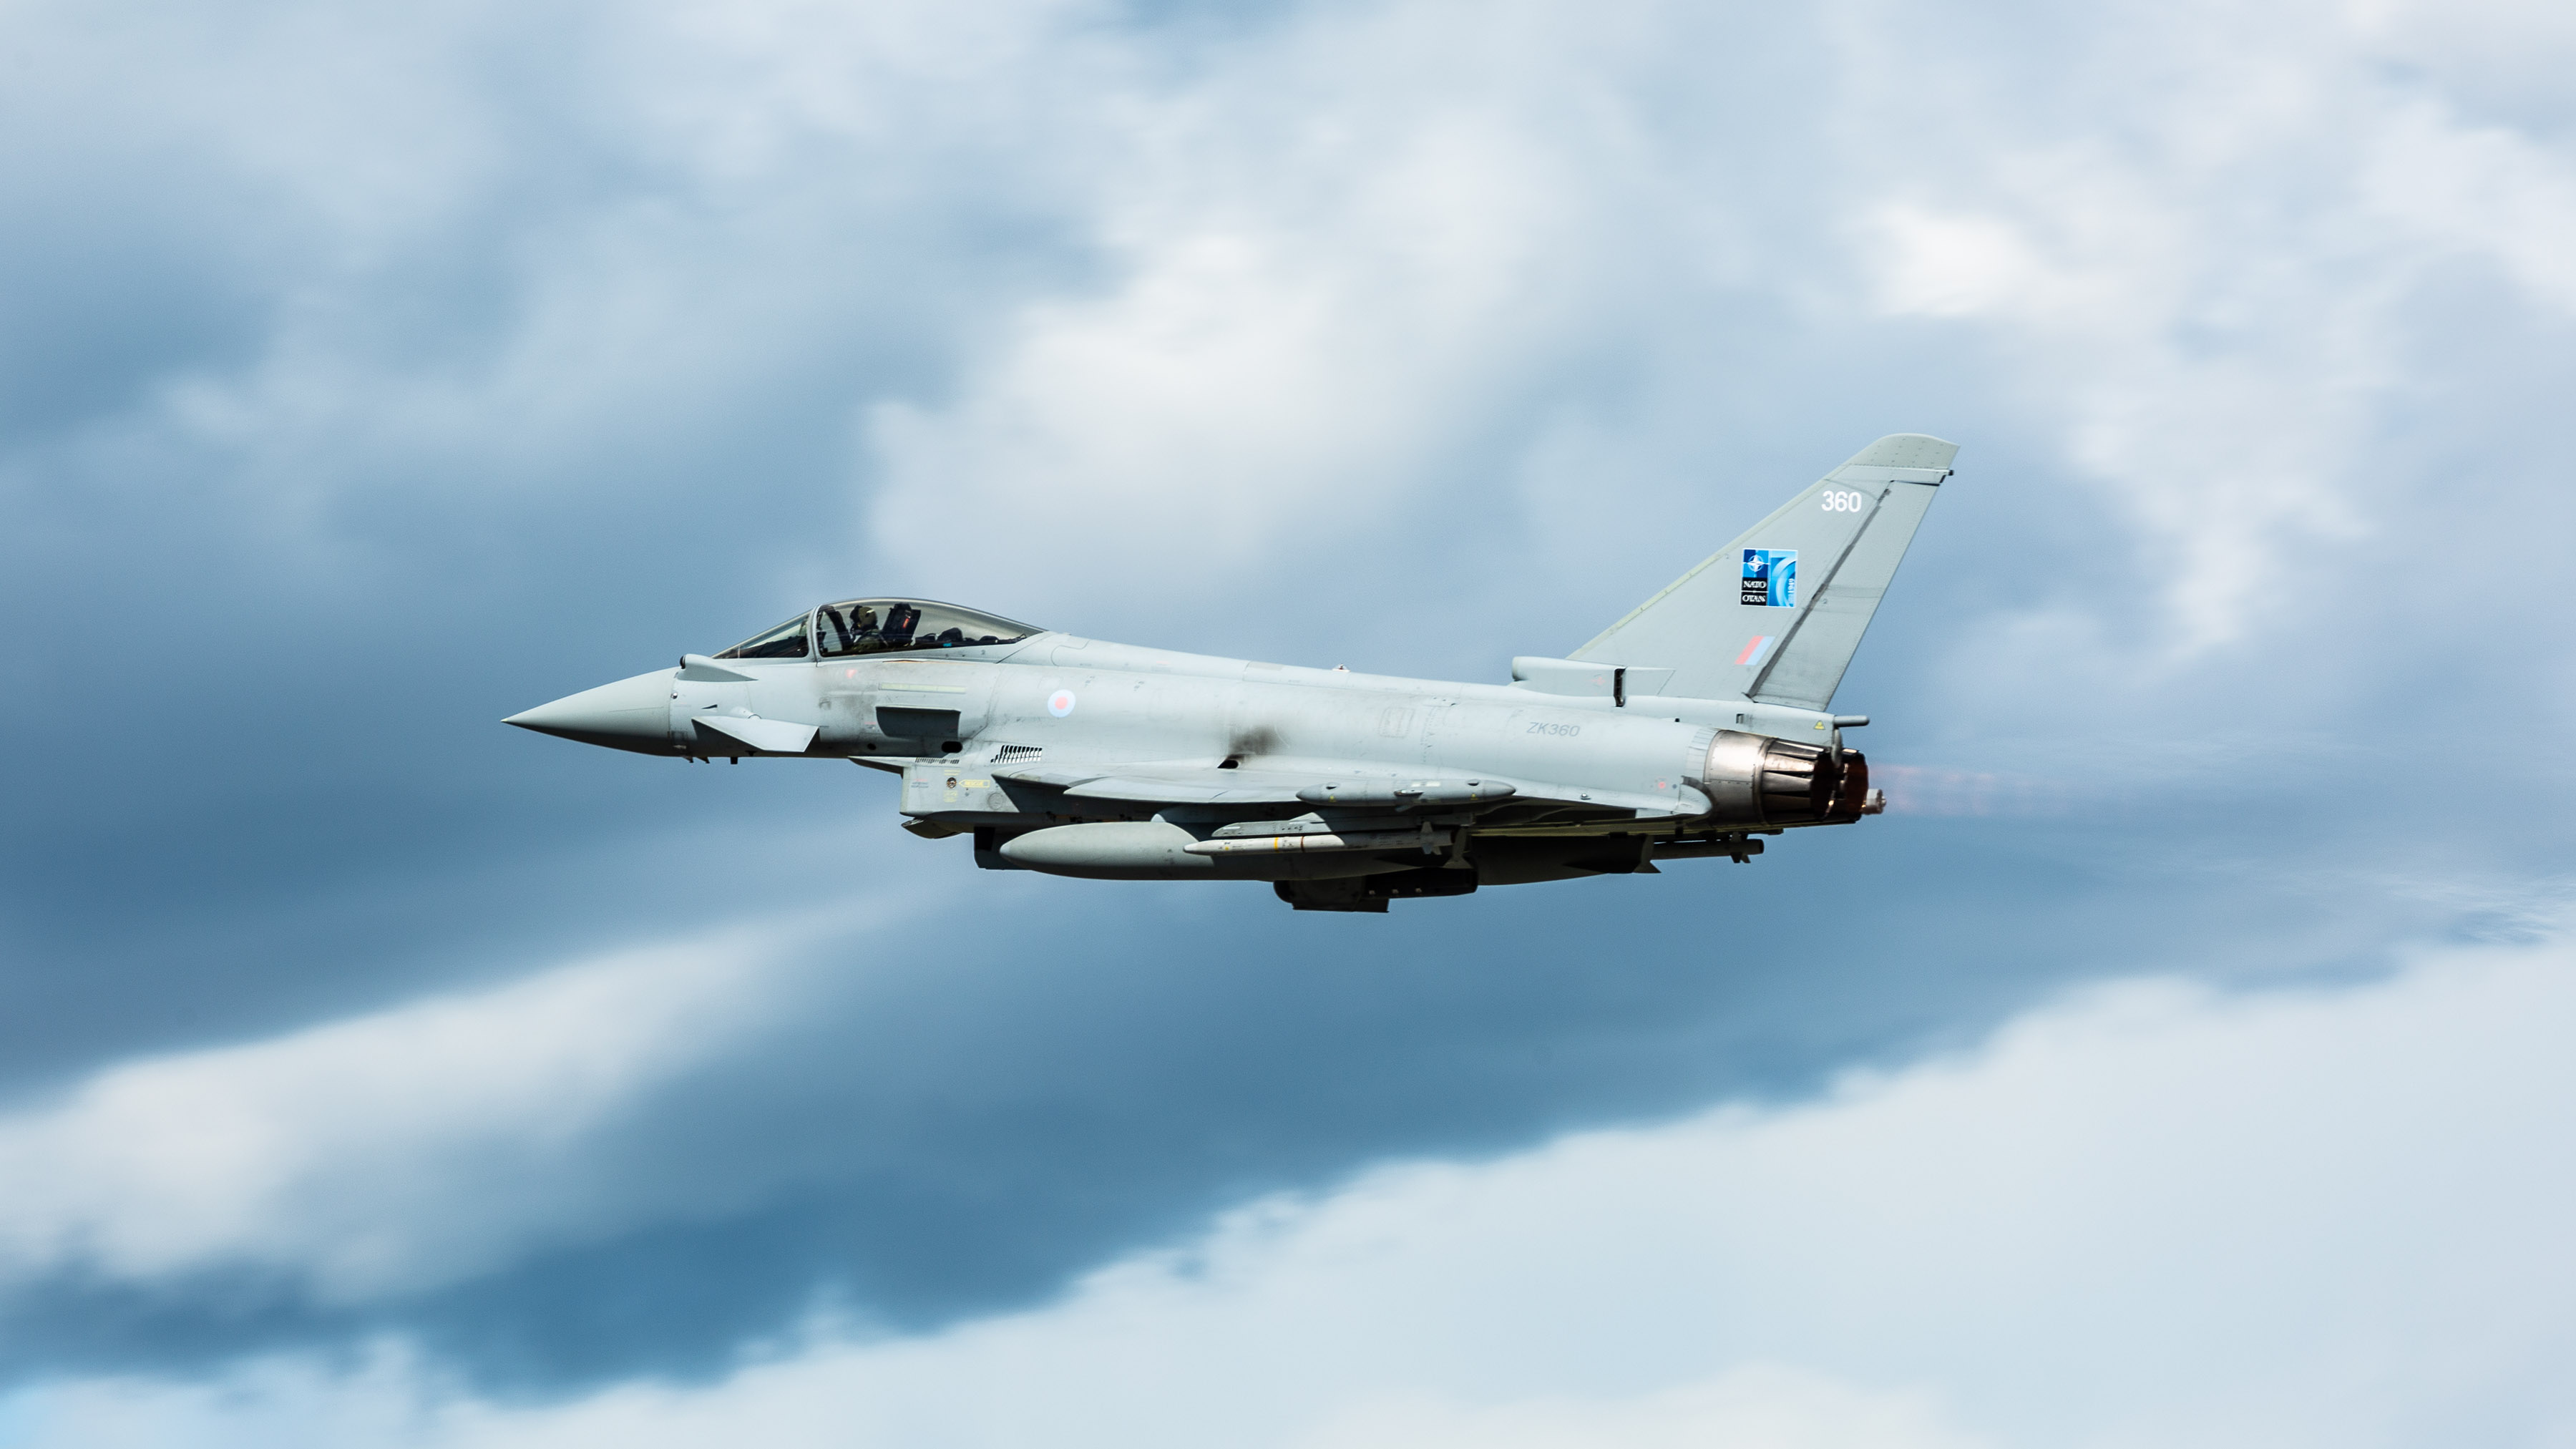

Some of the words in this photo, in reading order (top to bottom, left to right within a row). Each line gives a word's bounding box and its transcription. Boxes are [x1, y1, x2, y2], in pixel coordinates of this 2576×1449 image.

[1821, 490, 1862, 513] 360
[1743, 580, 1767, 589] NATO
[1742, 594, 1766, 602] OTAN
[1526, 721, 1581, 737] ZK360
